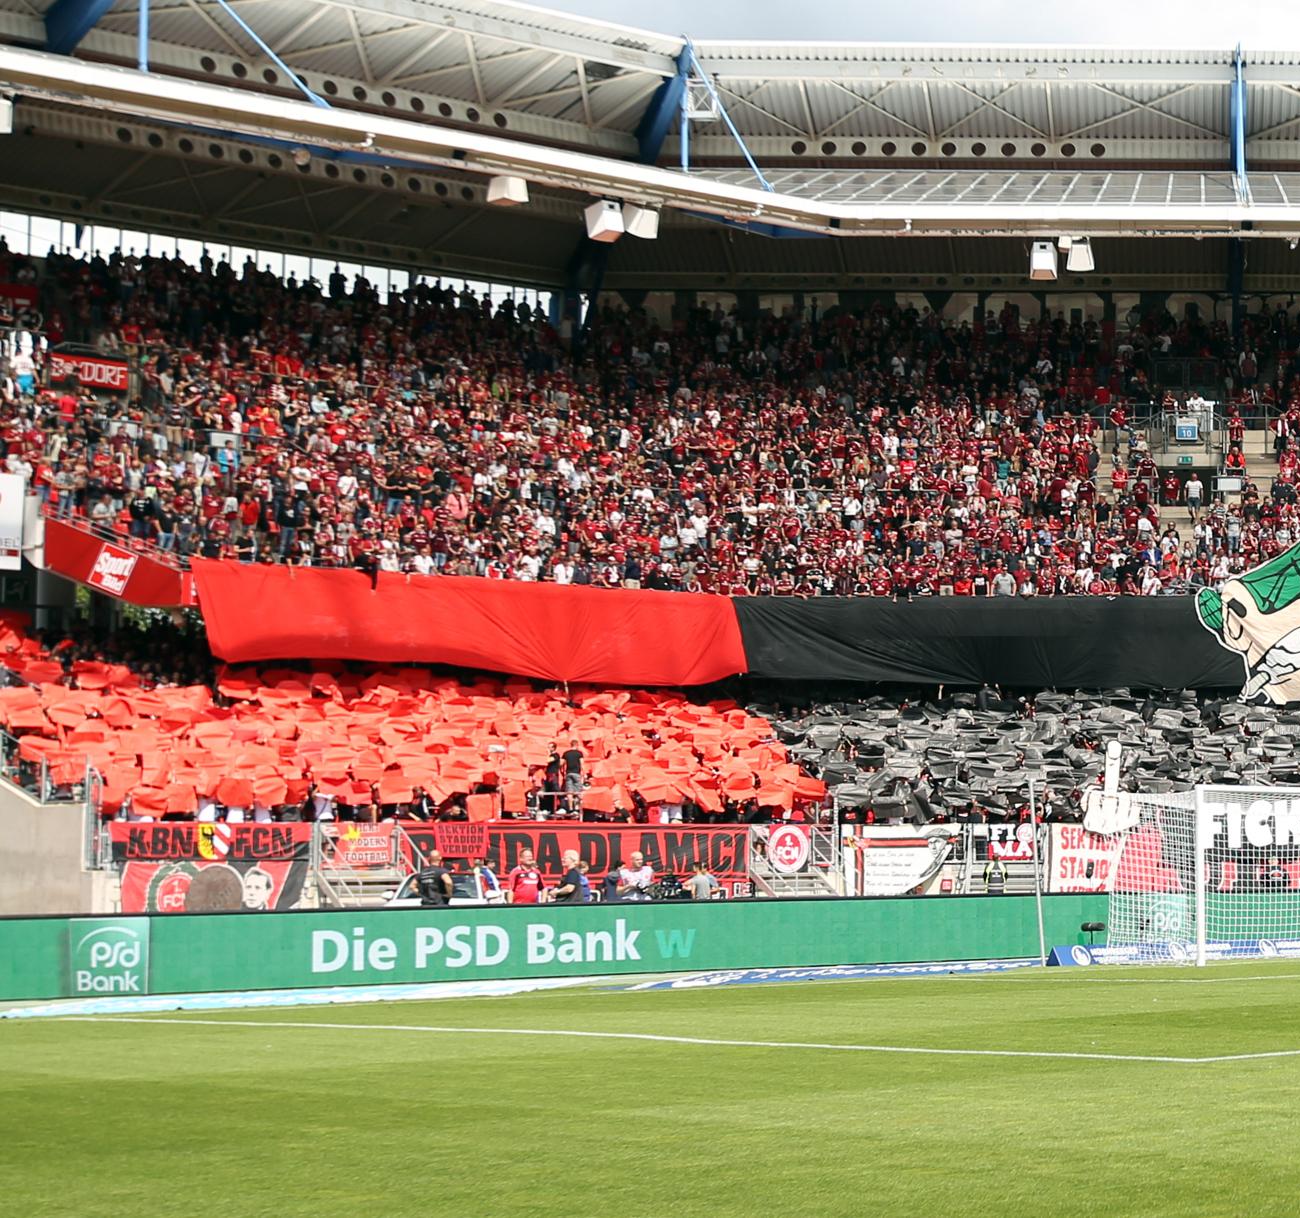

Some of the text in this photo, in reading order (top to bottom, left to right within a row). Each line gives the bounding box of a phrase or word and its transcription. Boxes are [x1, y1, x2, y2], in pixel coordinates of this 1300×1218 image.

[1183, 429, 1192, 438] 10
[94, 551, 136, 577] Sport
[438, 825, 484, 834] SEKTION
[440, 835, 484, 844] STADION
[126, 826, 294, 858] KBN FCN
[442, 844, 482, 854] VERBOT
[578, 832, 622, 874] DI
[637, 831, 747, 874] AMICI
[90, 940, 140, 969] psd
[311, 927, 397, 973] Die
[415, 924, 510, 970] PSD
[526, 919, 641, 964] Bank
[77, 970, 140, 993] Bank
